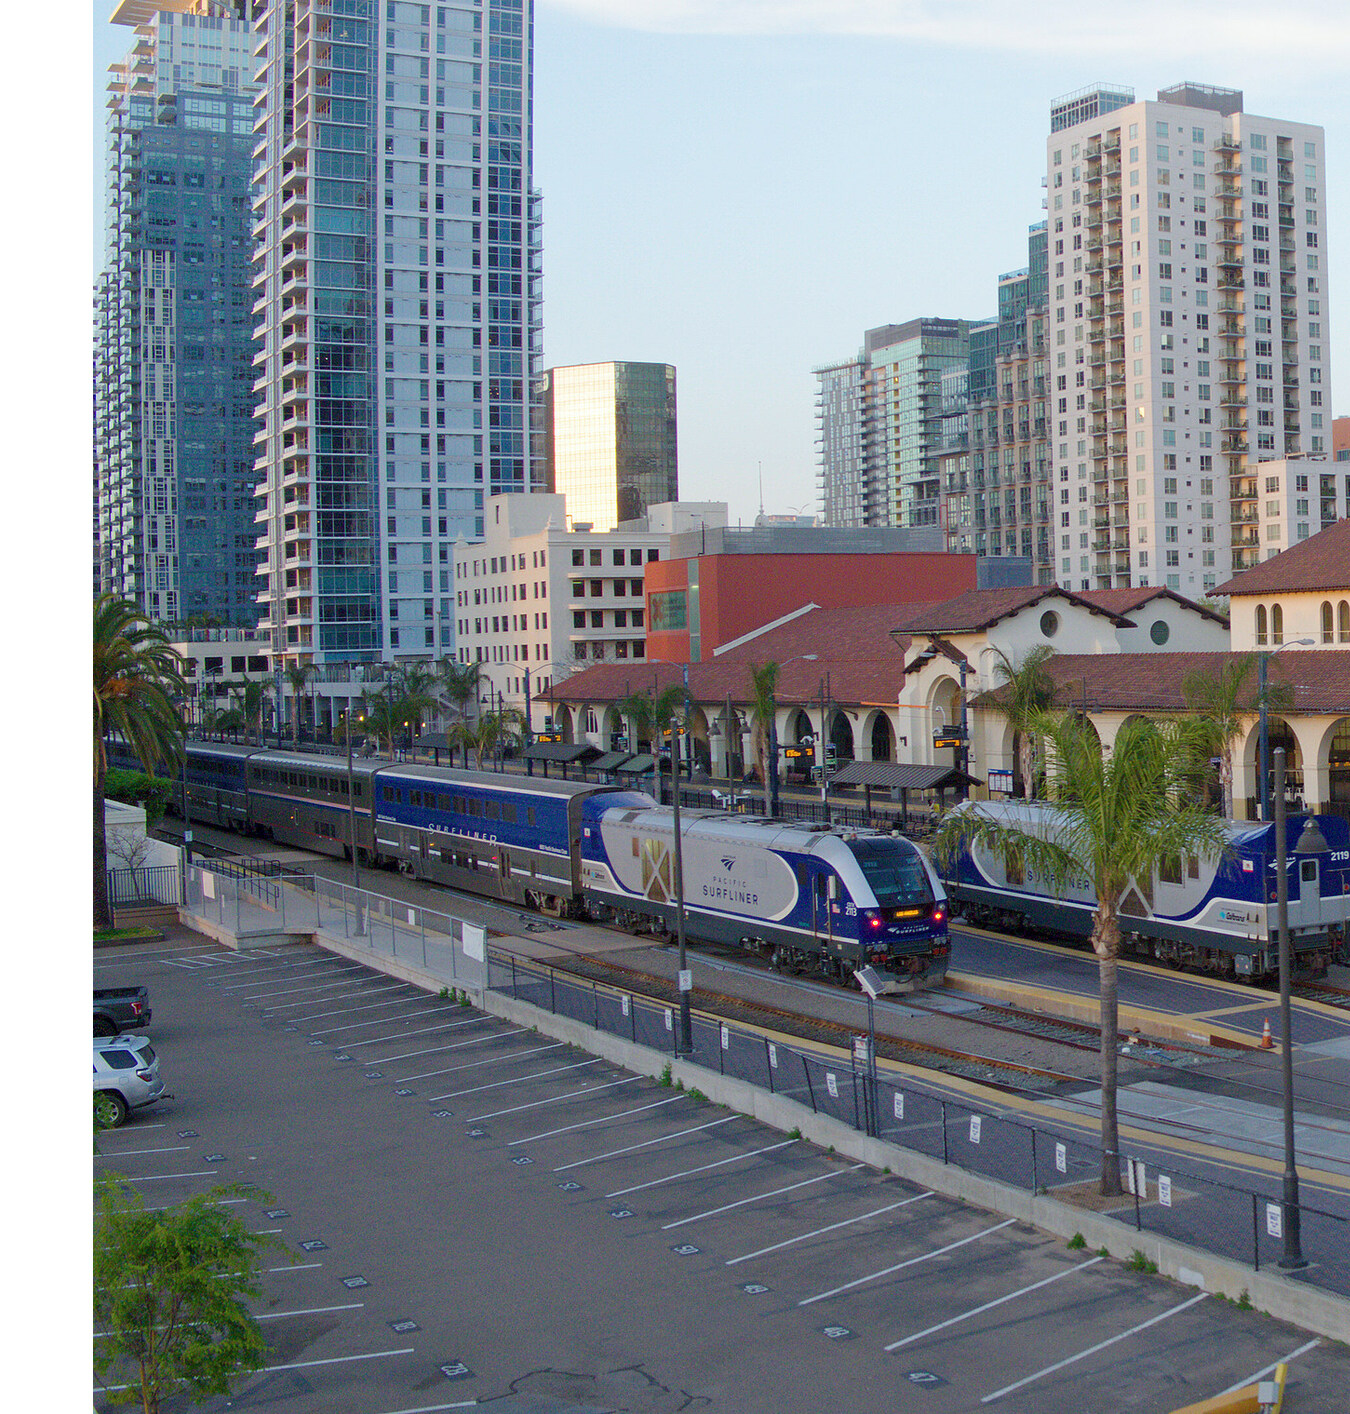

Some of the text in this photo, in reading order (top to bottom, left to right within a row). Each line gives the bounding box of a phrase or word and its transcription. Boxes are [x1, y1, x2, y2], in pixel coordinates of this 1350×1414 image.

[428, 823, 498, 847] SURFLINER
[1330, 850, 1350, 861] 2119
[713, 875, 747, 888] PACIFIC
[702, 884, 759, 905] SURFLINER
[743, 1284, 769, 1295] 49
[823, 1326, 850, 1338] 48
[908, 1372, 939, 1383] 47
